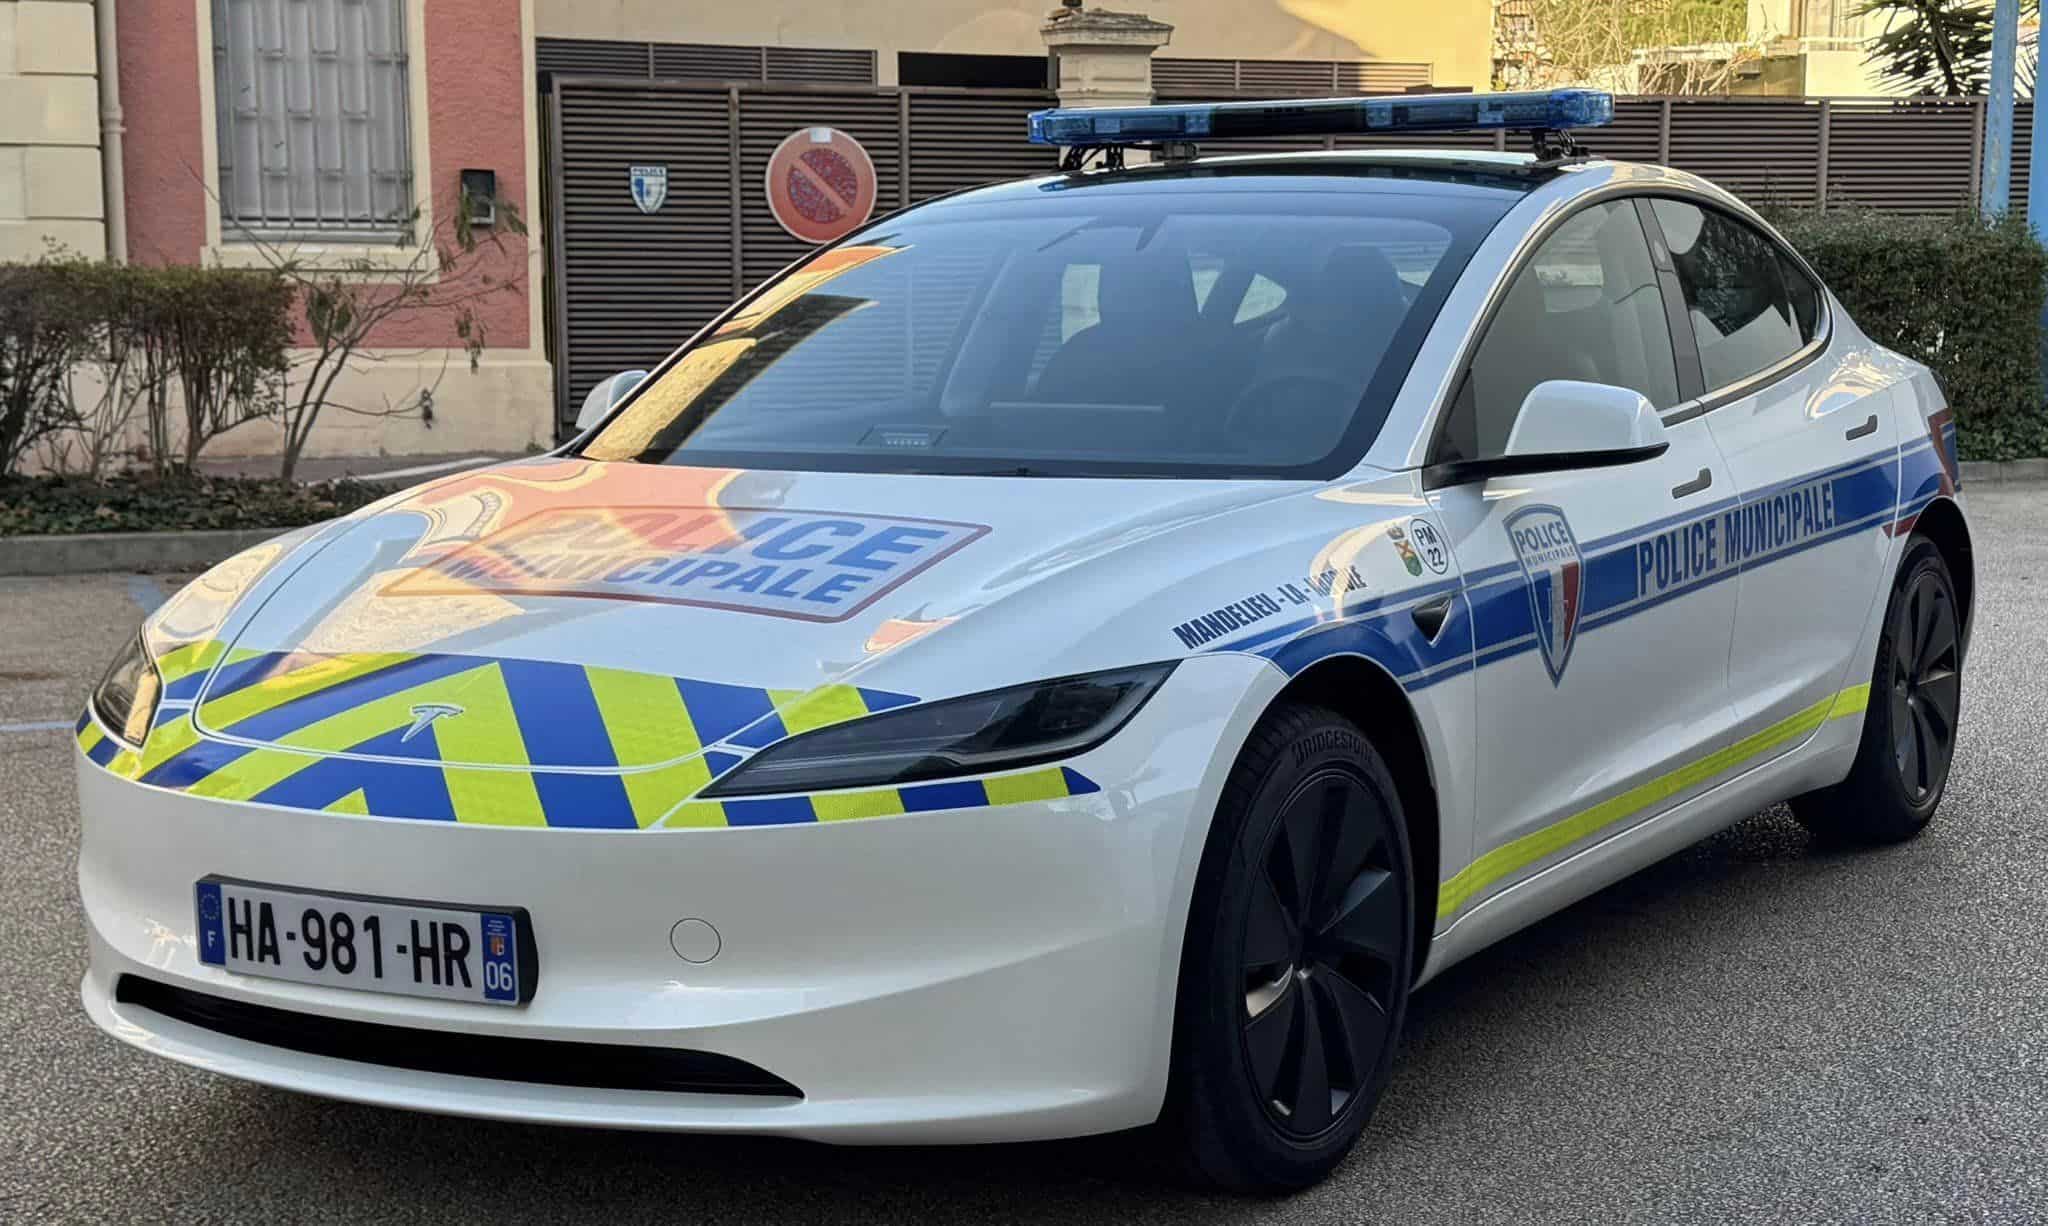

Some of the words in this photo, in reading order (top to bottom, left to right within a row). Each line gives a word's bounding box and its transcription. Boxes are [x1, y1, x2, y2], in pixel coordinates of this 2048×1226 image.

[1414, 526, 1437, 546] PM
[1514, 520, 1569, 553] POLICE
[1641, 518, 1717, 595] POLICE
[1725, 480, 1834, 565] MUNICIPALE
[1427, 547, 1445, 567] 22
[1525, 546, 1576, 567] MUNICIPALE
[206, 930, 217, 948] F
[228, 897, 473, 989] HA-981-HR
[486, 960, 513, 992] 06
